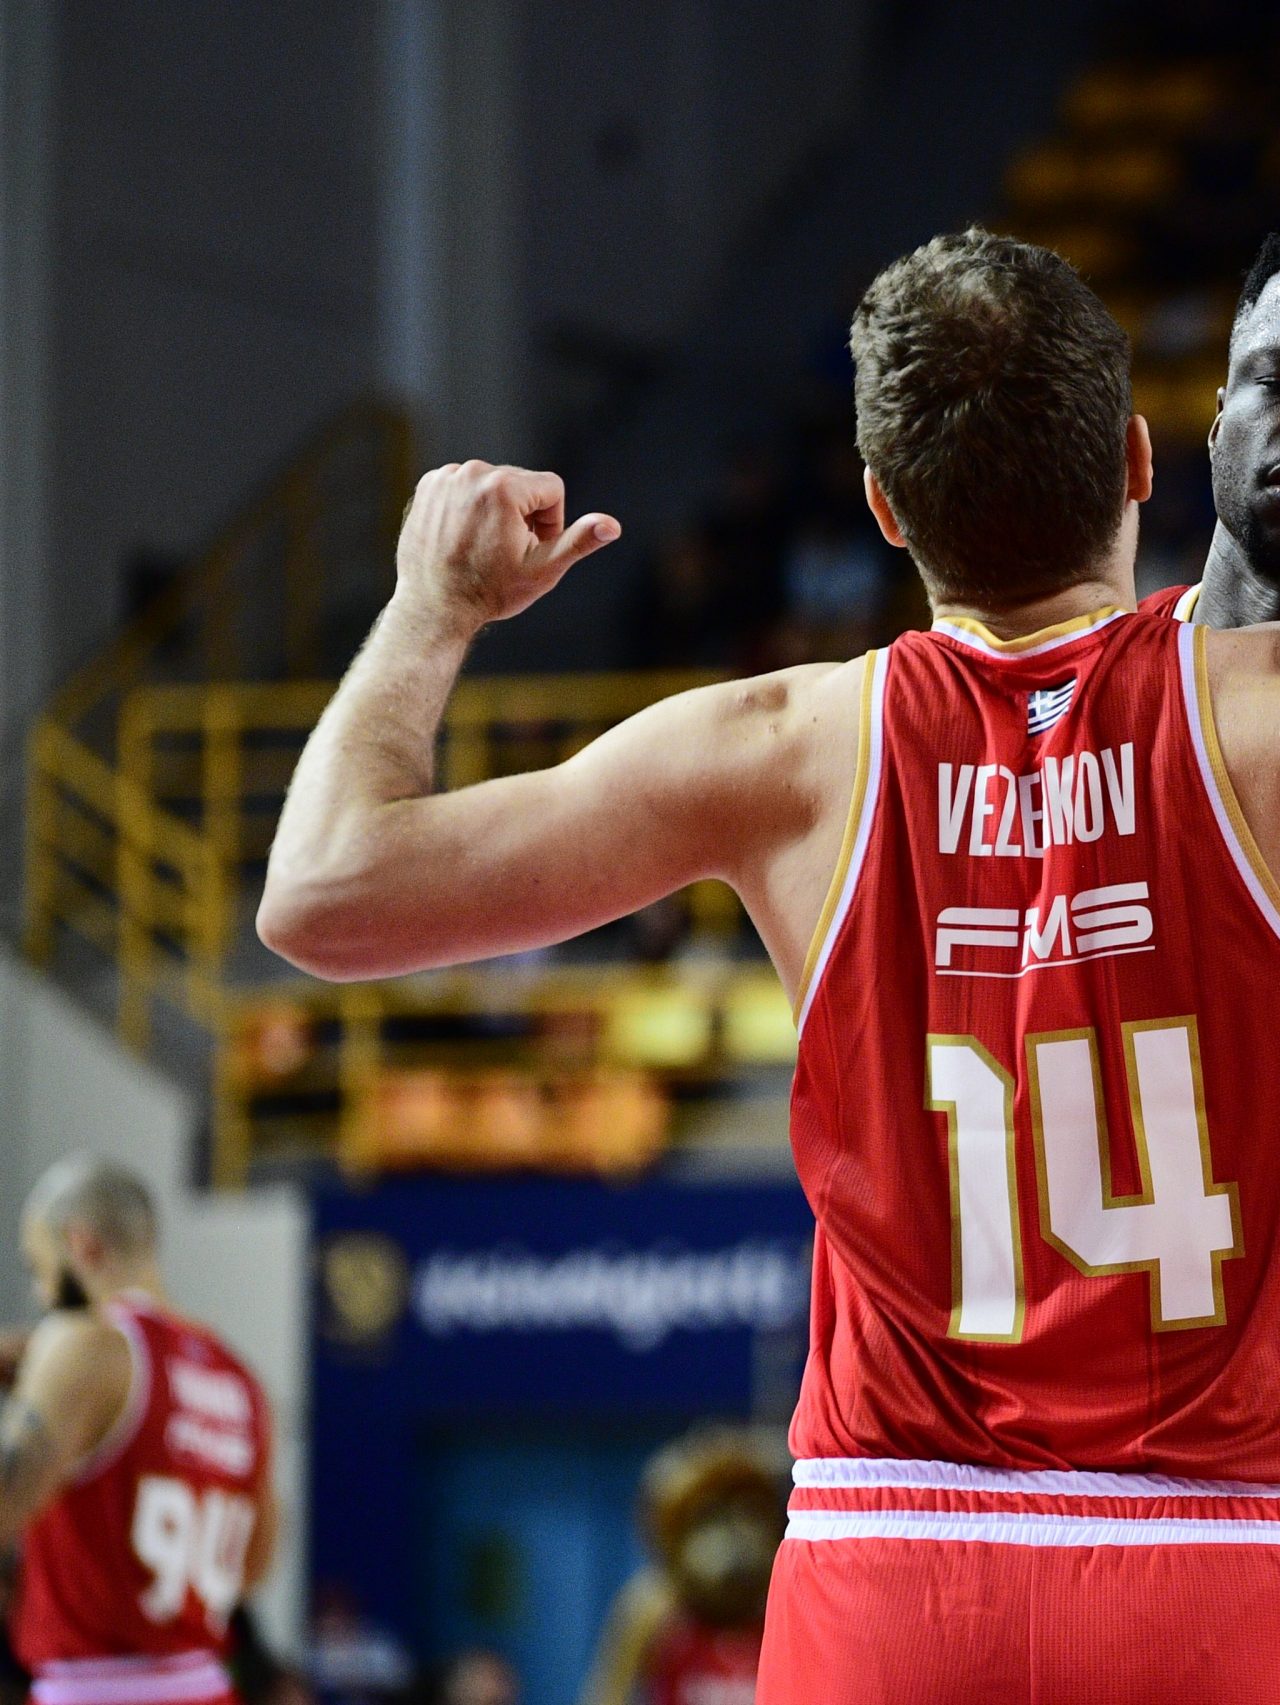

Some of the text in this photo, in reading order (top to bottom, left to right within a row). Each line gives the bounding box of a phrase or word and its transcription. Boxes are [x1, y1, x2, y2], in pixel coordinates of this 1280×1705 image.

[935, 881, 1154, 967] FMS
[923, 1014, 1246, 1344] 14
[134, 1474, 256, 1636] 94
